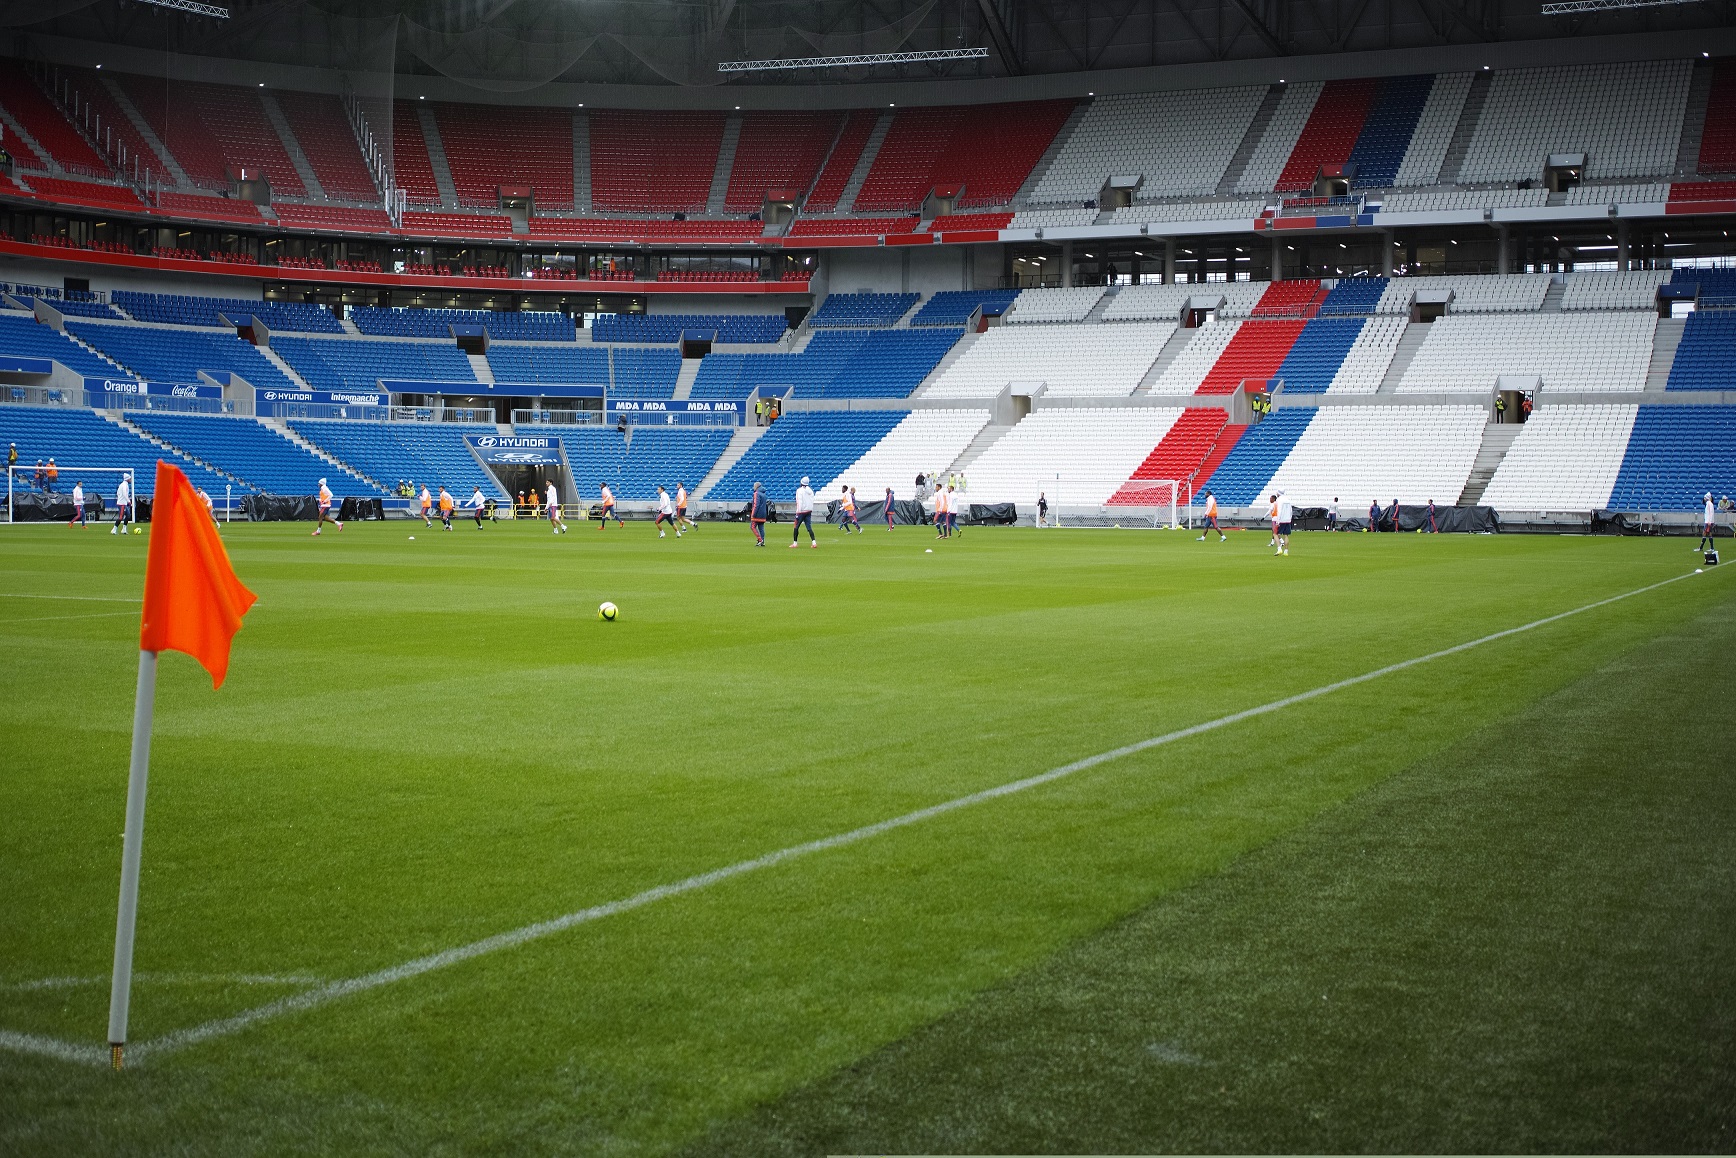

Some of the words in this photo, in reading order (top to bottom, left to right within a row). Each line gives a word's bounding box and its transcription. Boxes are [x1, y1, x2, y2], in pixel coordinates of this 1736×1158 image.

[104, 380, 138, 393] Orange
[278, 393, 312, 401] HYUNDAI
[615, 401, 640, 410] MDA
[643, 402, 667, 411] MDA
[687, 402, 711, 411] MDA
[714, 402, 738, 411] MDA
[500, 438, 549, 447] HYUNDAI
